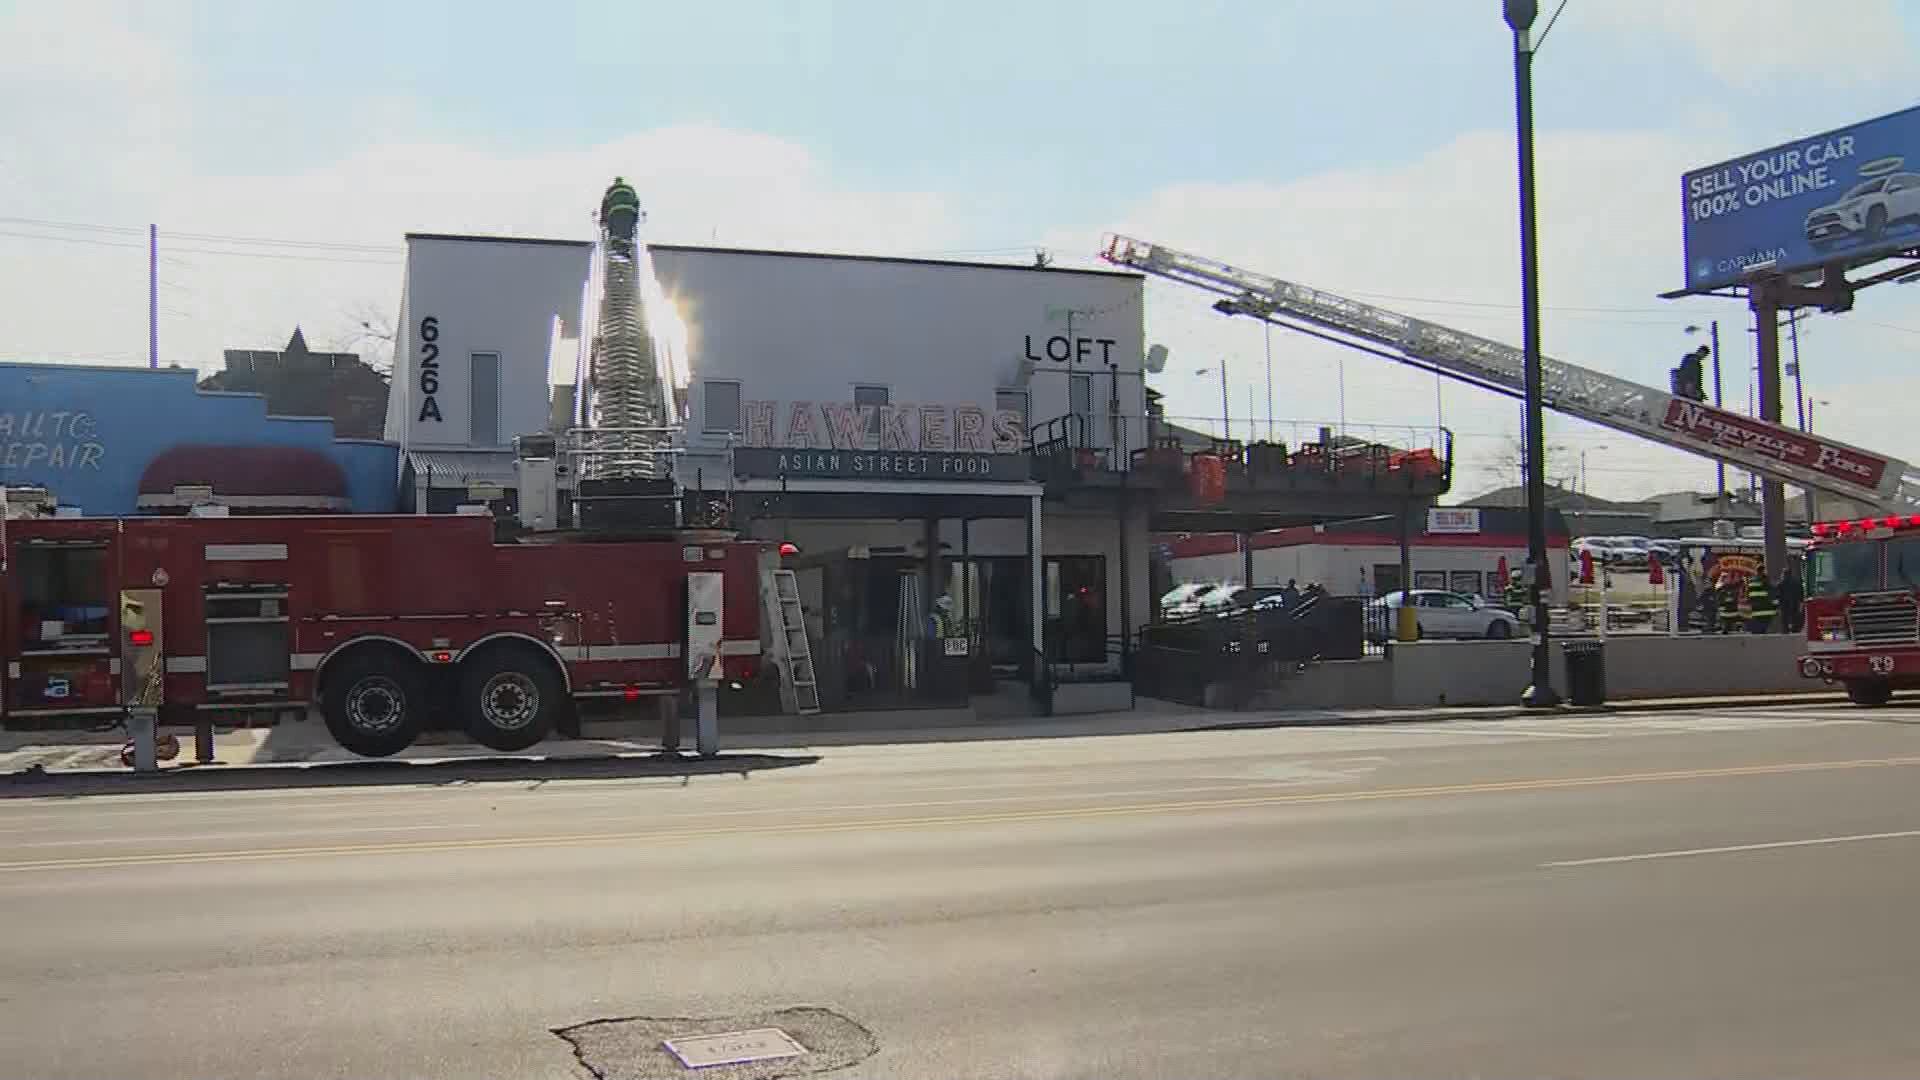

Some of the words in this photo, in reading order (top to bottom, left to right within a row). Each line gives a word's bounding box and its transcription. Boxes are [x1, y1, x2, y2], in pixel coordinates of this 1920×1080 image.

[1690, 169, 1738, 198] SELL
[1738, 151, 1801, 184] YOUR
[1805, 135, 1856, 166] CAR
[1690, 190, 1741, 222] 100%
[1743, 166, 1837, 207] ONLINE.
[1717, 247, 1787, 273] CARVANA
[1025, 335, 1116, 364] LOFT
[418, 315, 443, 422] 626A
[743, 400, 1026, 455] HAWKERS
[0, 441, 105, 471] EPAIR
[779, 455, 842, 472] ASIAN
[853, 456, 932, 474] STREET
[942, 457, 992, 475] FOOD
[1867, 655, 1896, 672] T9
